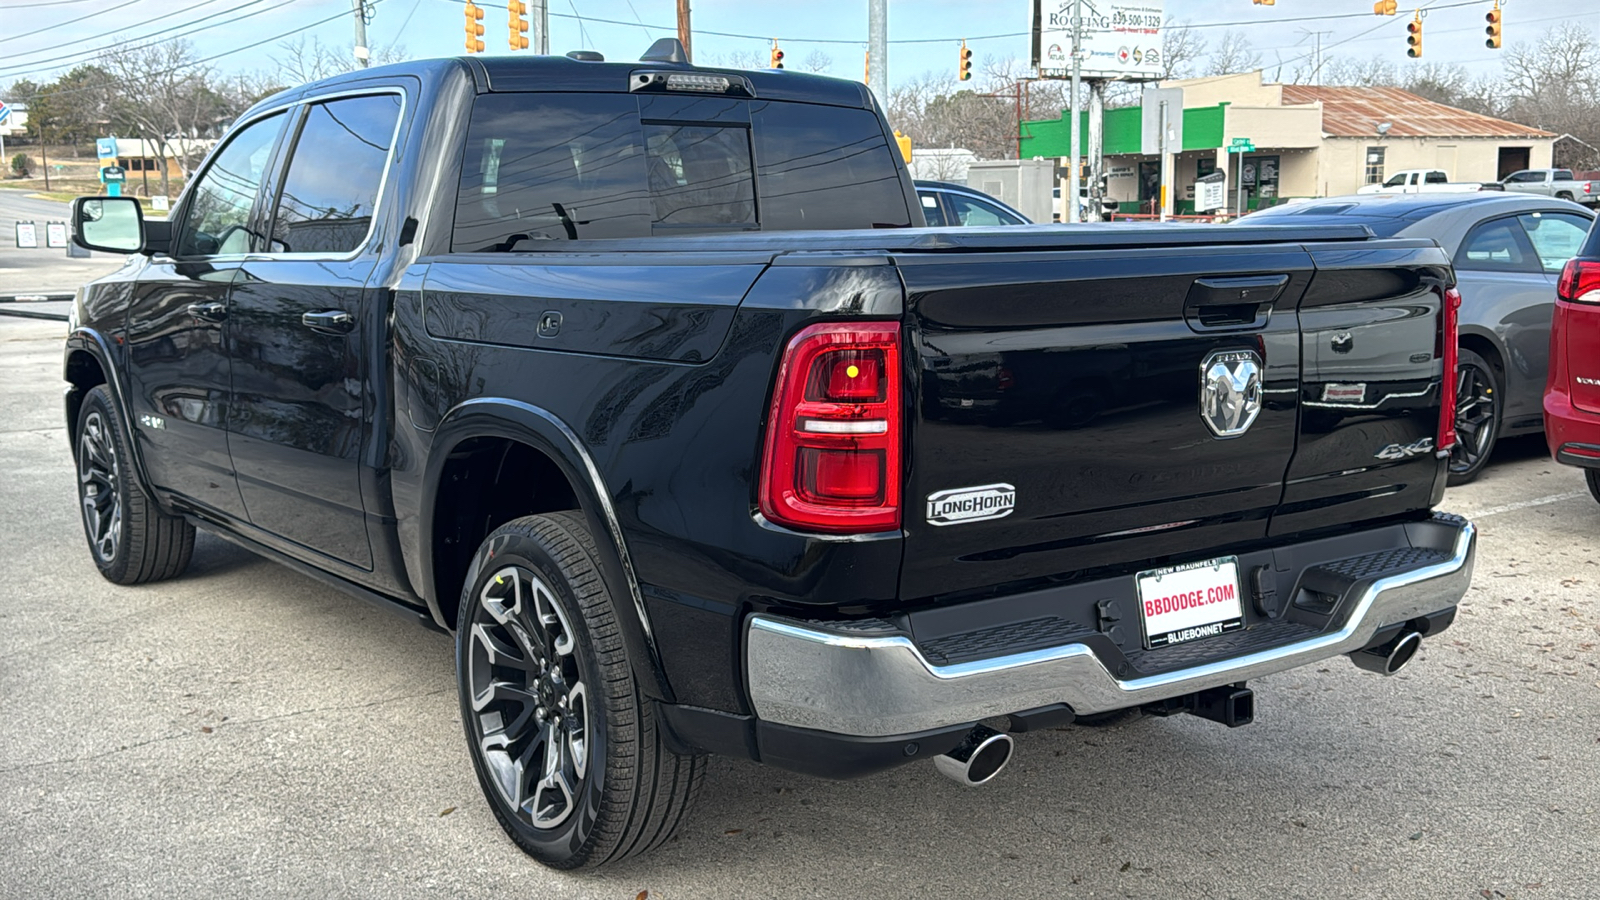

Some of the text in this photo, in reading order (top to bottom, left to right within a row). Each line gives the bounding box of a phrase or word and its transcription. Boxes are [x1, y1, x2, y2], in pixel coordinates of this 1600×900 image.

[1157, 559, 1217, 575] NEW BRAUNFELS
[1145, 583, 1235, 617] BBDODGE.COM
[1167, 622, 1223, 643] BLUEBONNET
